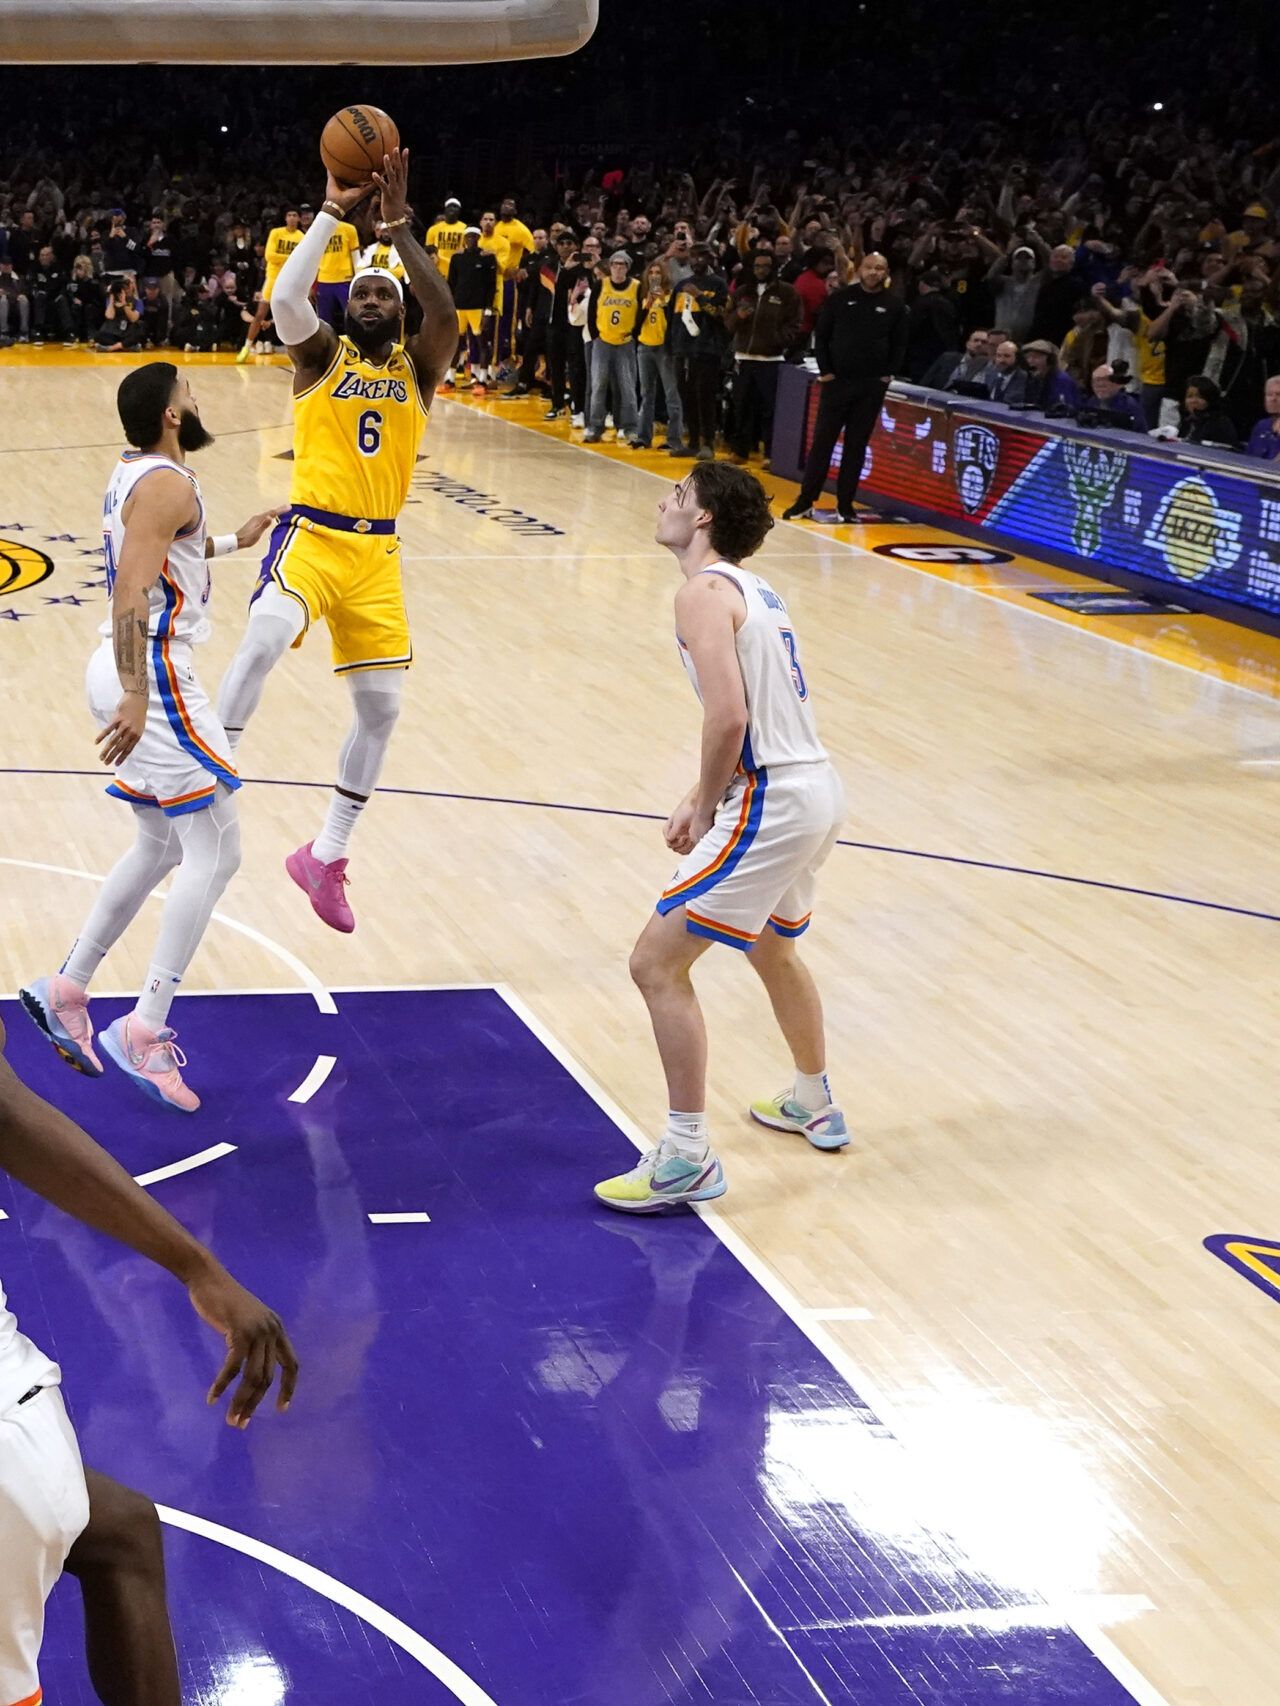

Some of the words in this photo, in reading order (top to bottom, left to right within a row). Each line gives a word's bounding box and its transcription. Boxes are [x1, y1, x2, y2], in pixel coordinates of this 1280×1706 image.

[611, 310, 621, 325] 6
[330, 371, 408, 403] LAKERS
[357, 409, 383, 457] 6
